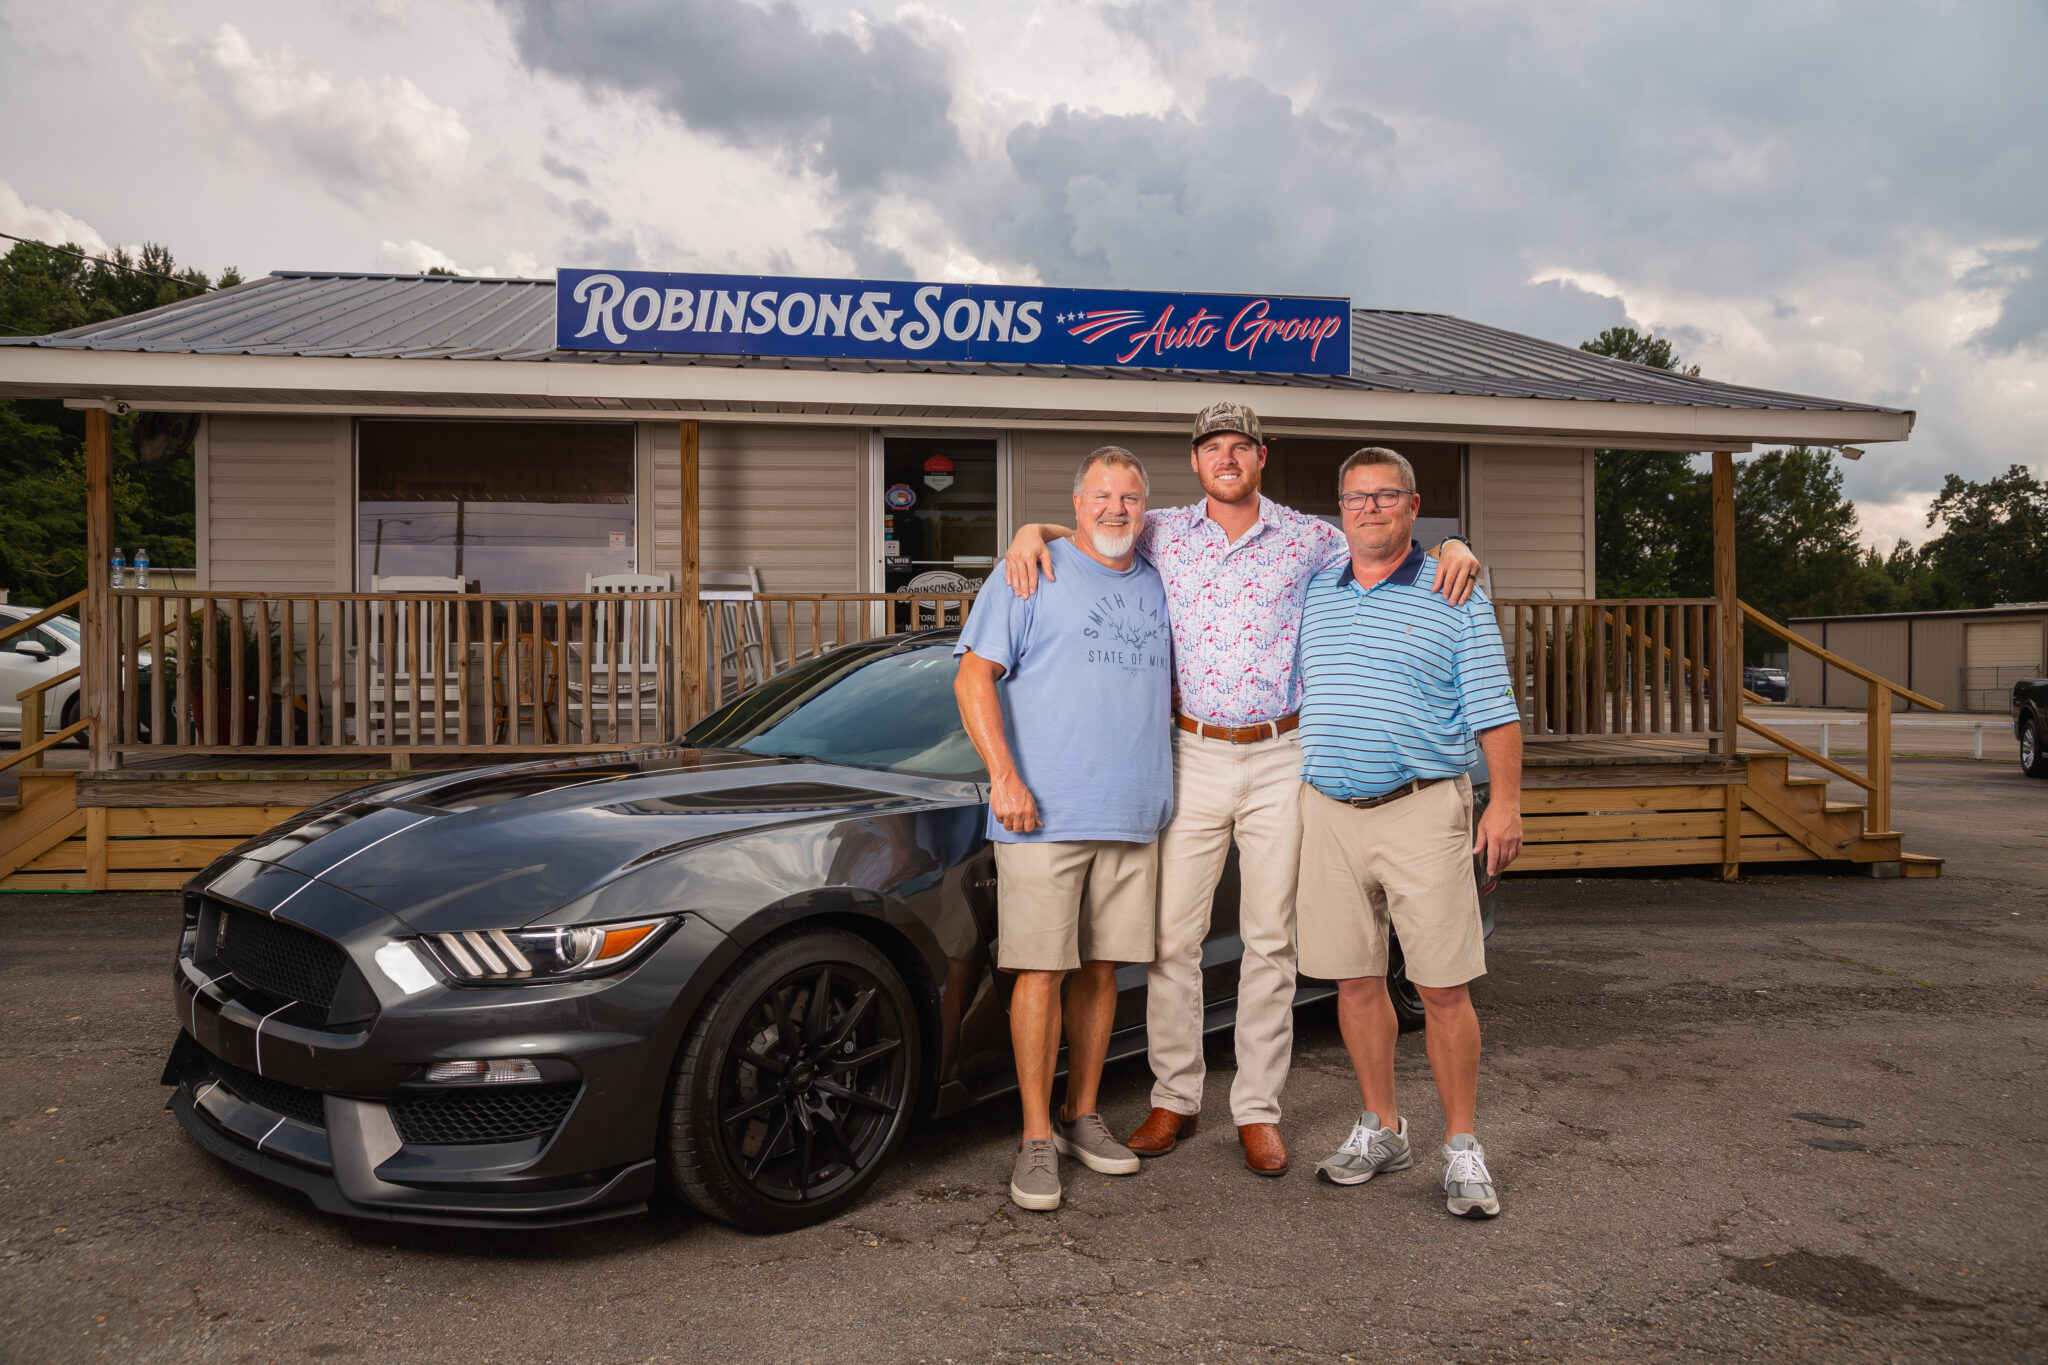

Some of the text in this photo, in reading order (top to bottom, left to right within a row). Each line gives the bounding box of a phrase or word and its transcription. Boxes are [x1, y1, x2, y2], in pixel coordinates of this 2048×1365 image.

[1116, 304, 1224, 363] Auto
[1224, 299, 1342, 362] Group
[1083, 593, 1126, 639] SMITH
[1088, 650, 1123, 664] STATE
[1131, 653, 1144, 665] OF
